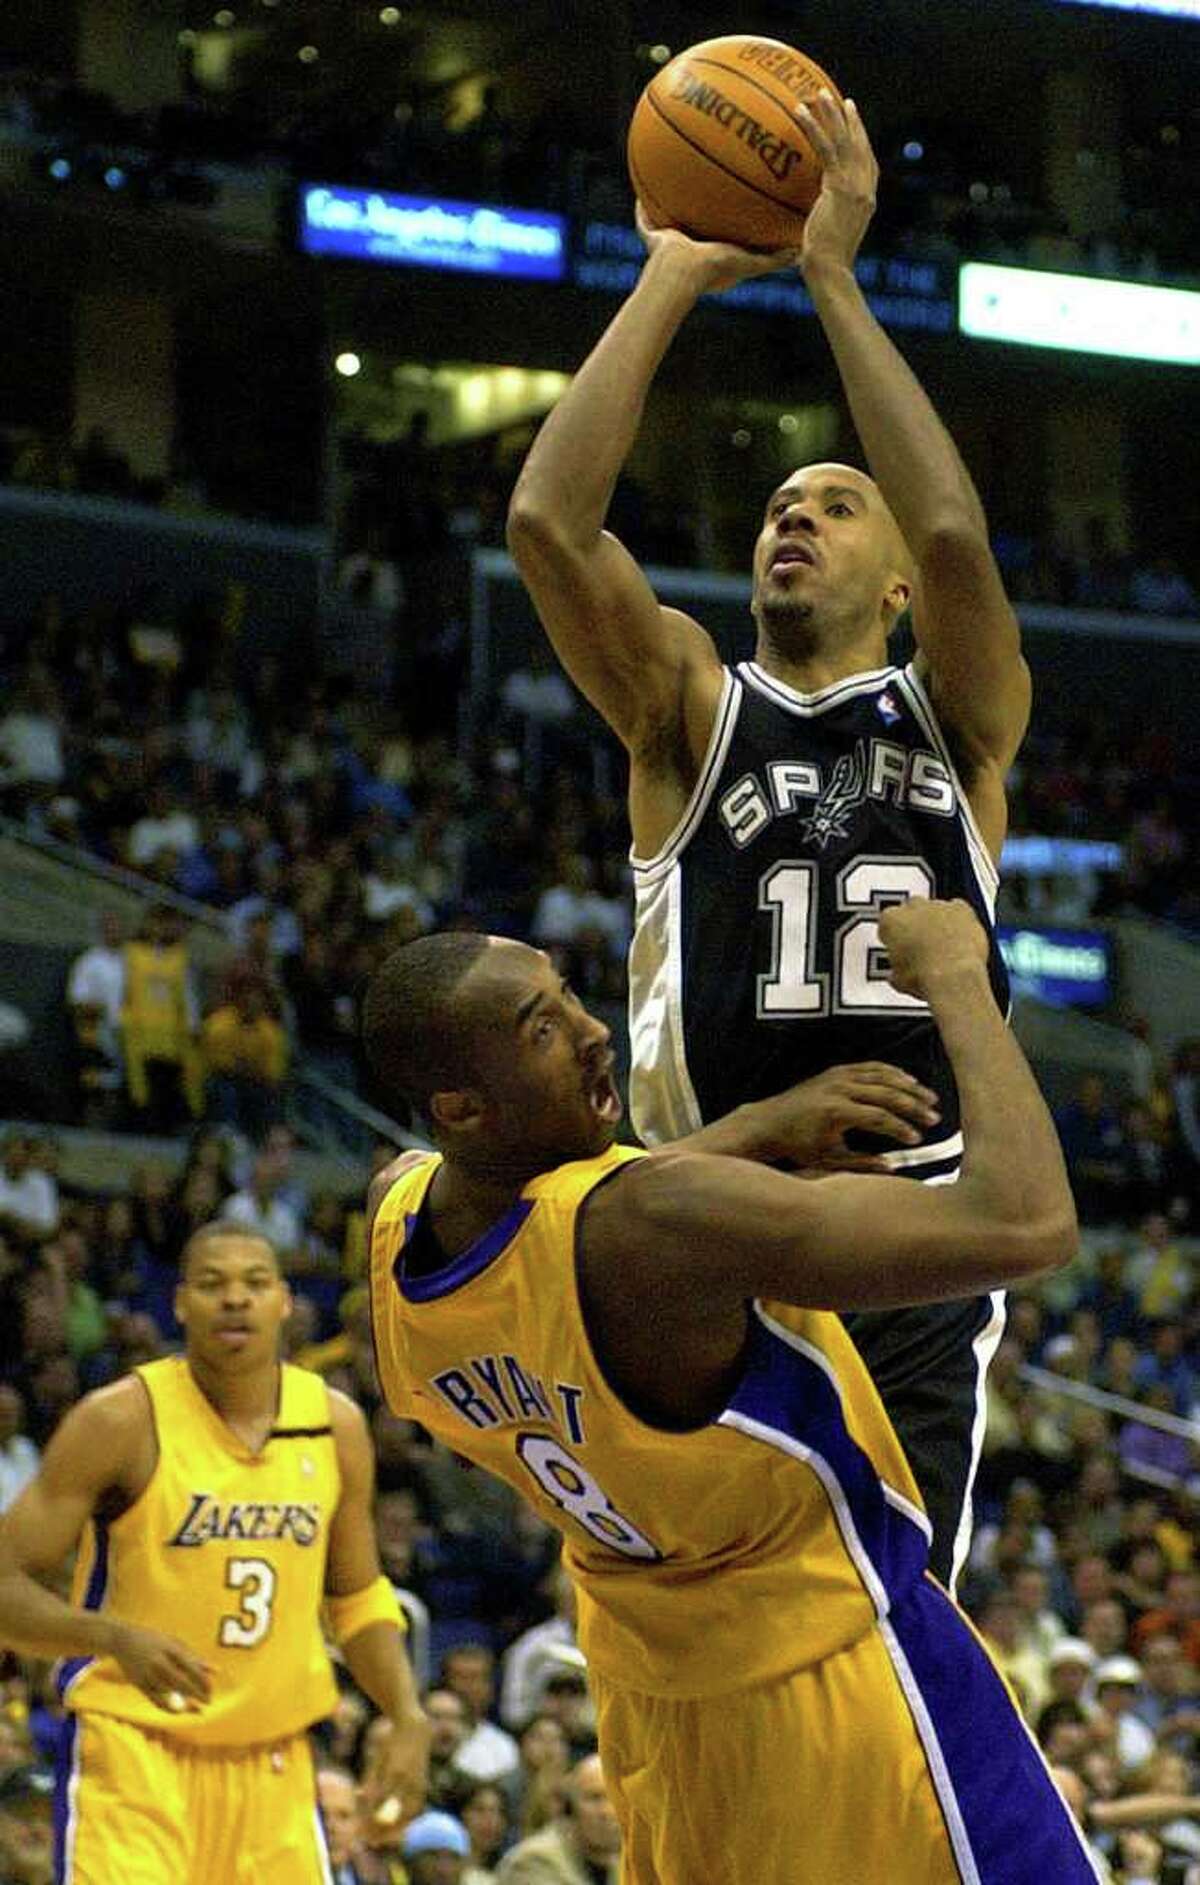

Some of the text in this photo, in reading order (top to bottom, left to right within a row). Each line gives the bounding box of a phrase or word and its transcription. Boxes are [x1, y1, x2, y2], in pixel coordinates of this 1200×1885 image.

[671, 70, 802, 181] SPALDING
[756, 854, 937, 1020] 12
[430, 1354, 588, 1446] RYAT
[167, 1492, 319, 1547] LAKERS
[516, 1432, 662, 1561] 8
[218, 1556, 278, 1649] 3
